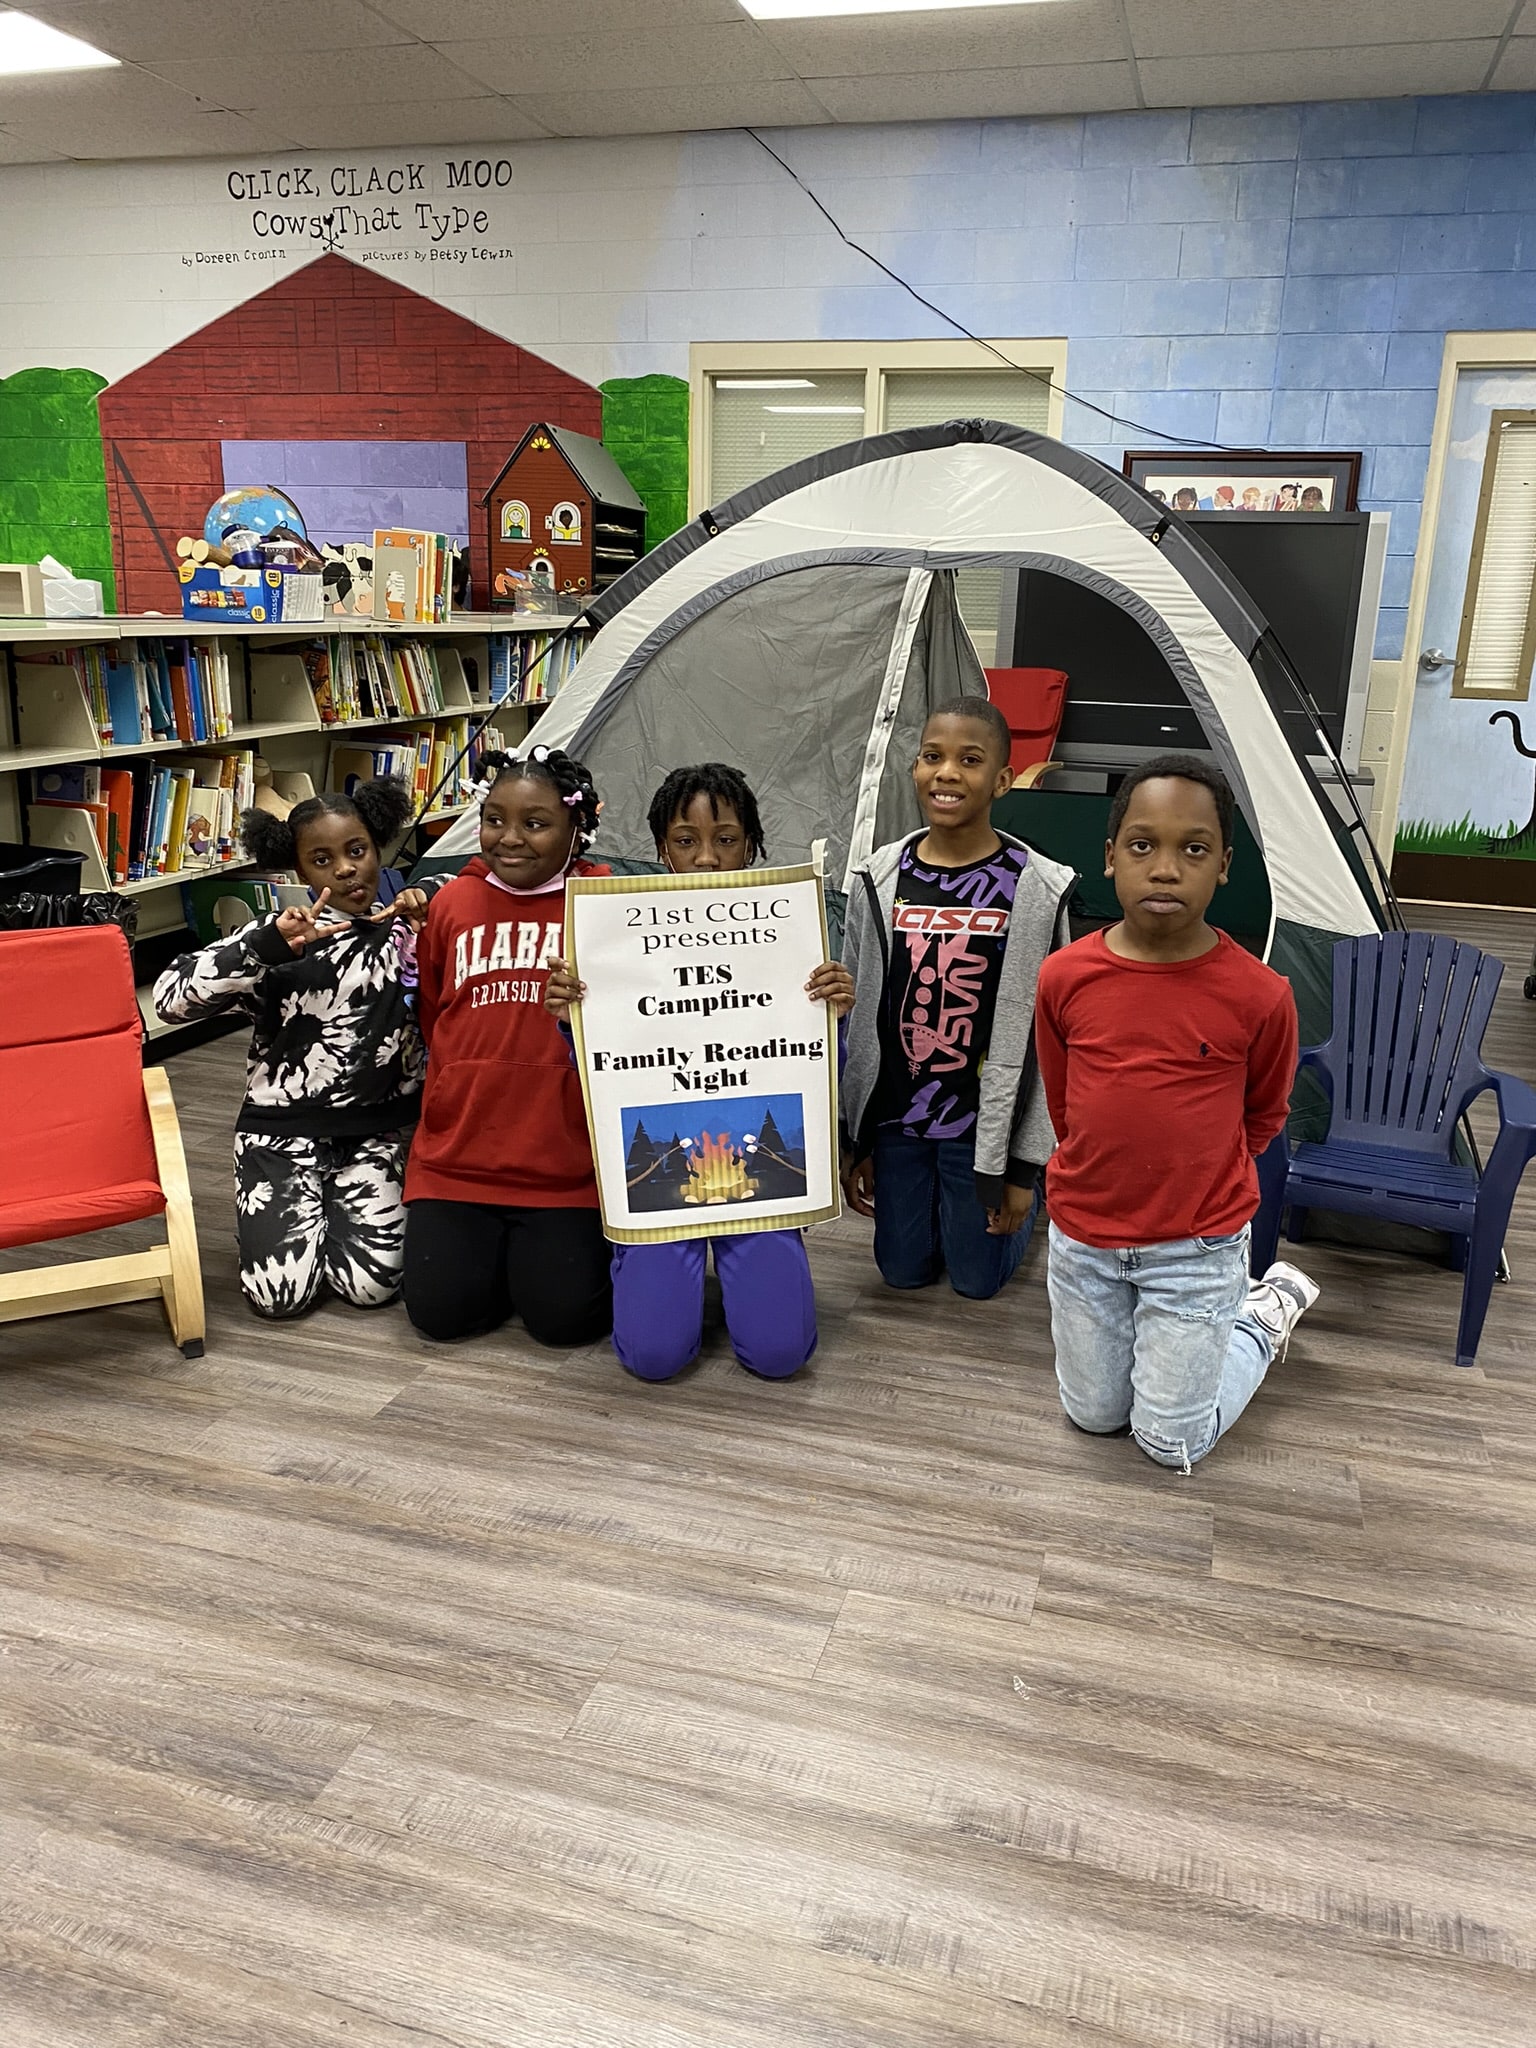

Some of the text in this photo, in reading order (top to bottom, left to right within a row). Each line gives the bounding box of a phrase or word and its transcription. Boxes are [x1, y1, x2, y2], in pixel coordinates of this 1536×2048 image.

[227, 160, 513, 200] CLICK, CLACK MOO
[252, 203, 489, 242] Cows That Type
[181, 255, 193, 267] by
[195, 252, 240, 265] Doreen
[362, 247, 514, 264] pictures by Betsy Lewin
[625, 899, 792, 928] 21st CCLC
[641, 926, 779, 955] presents
[673, 963, 733, 988] TES
[471, 980, 541, 1009] CRIMSON
[637, 989, 774, 1017] Campfire
[592, 1037, 824, 1072] Family Reading
[671, 1067, 751, 1094] Night
